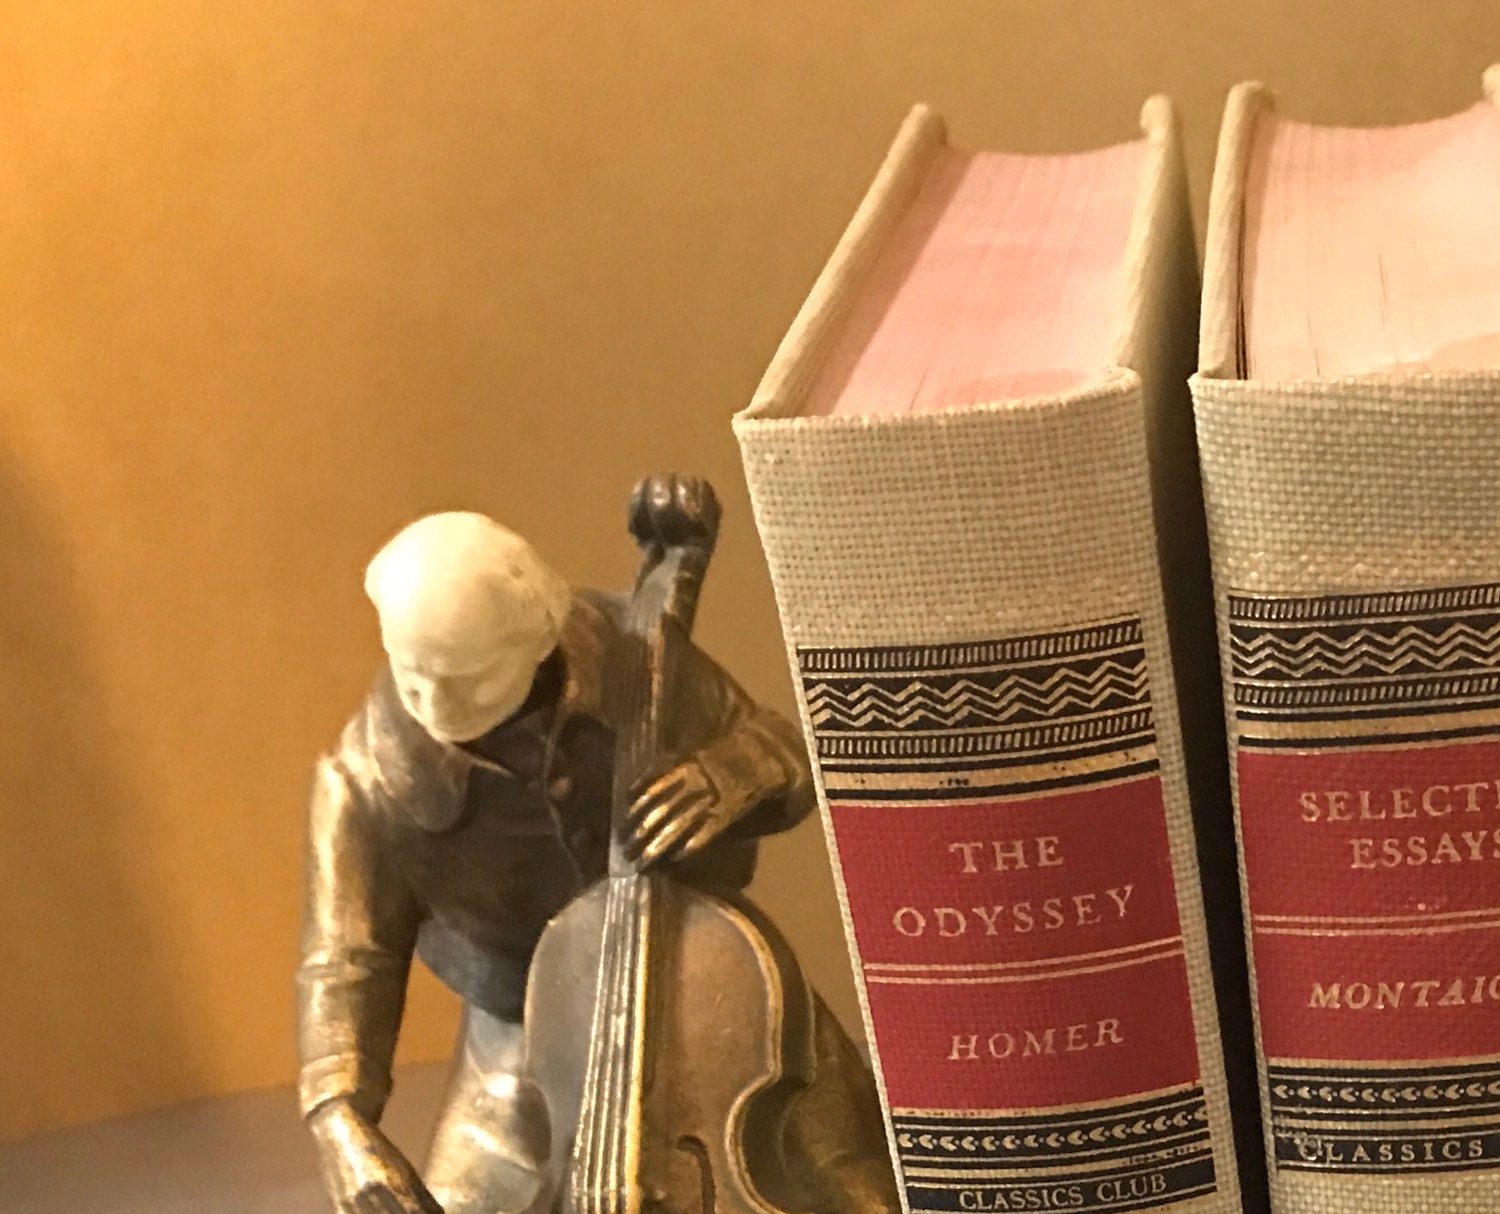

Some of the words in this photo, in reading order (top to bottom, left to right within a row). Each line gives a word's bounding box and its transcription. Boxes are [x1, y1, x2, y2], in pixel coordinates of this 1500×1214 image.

[949, 836, 1064, 873] THE
[892, 884, 1135, 938] ODYSSEY
[947, 1018, 1125, 1061] HOMER
[1300, 1137, 1484, 1165] CLASSICS
[959, 1187, 1085, 1212] CLASSICS
[1097, 1173, 1167, 1202] CLUB
